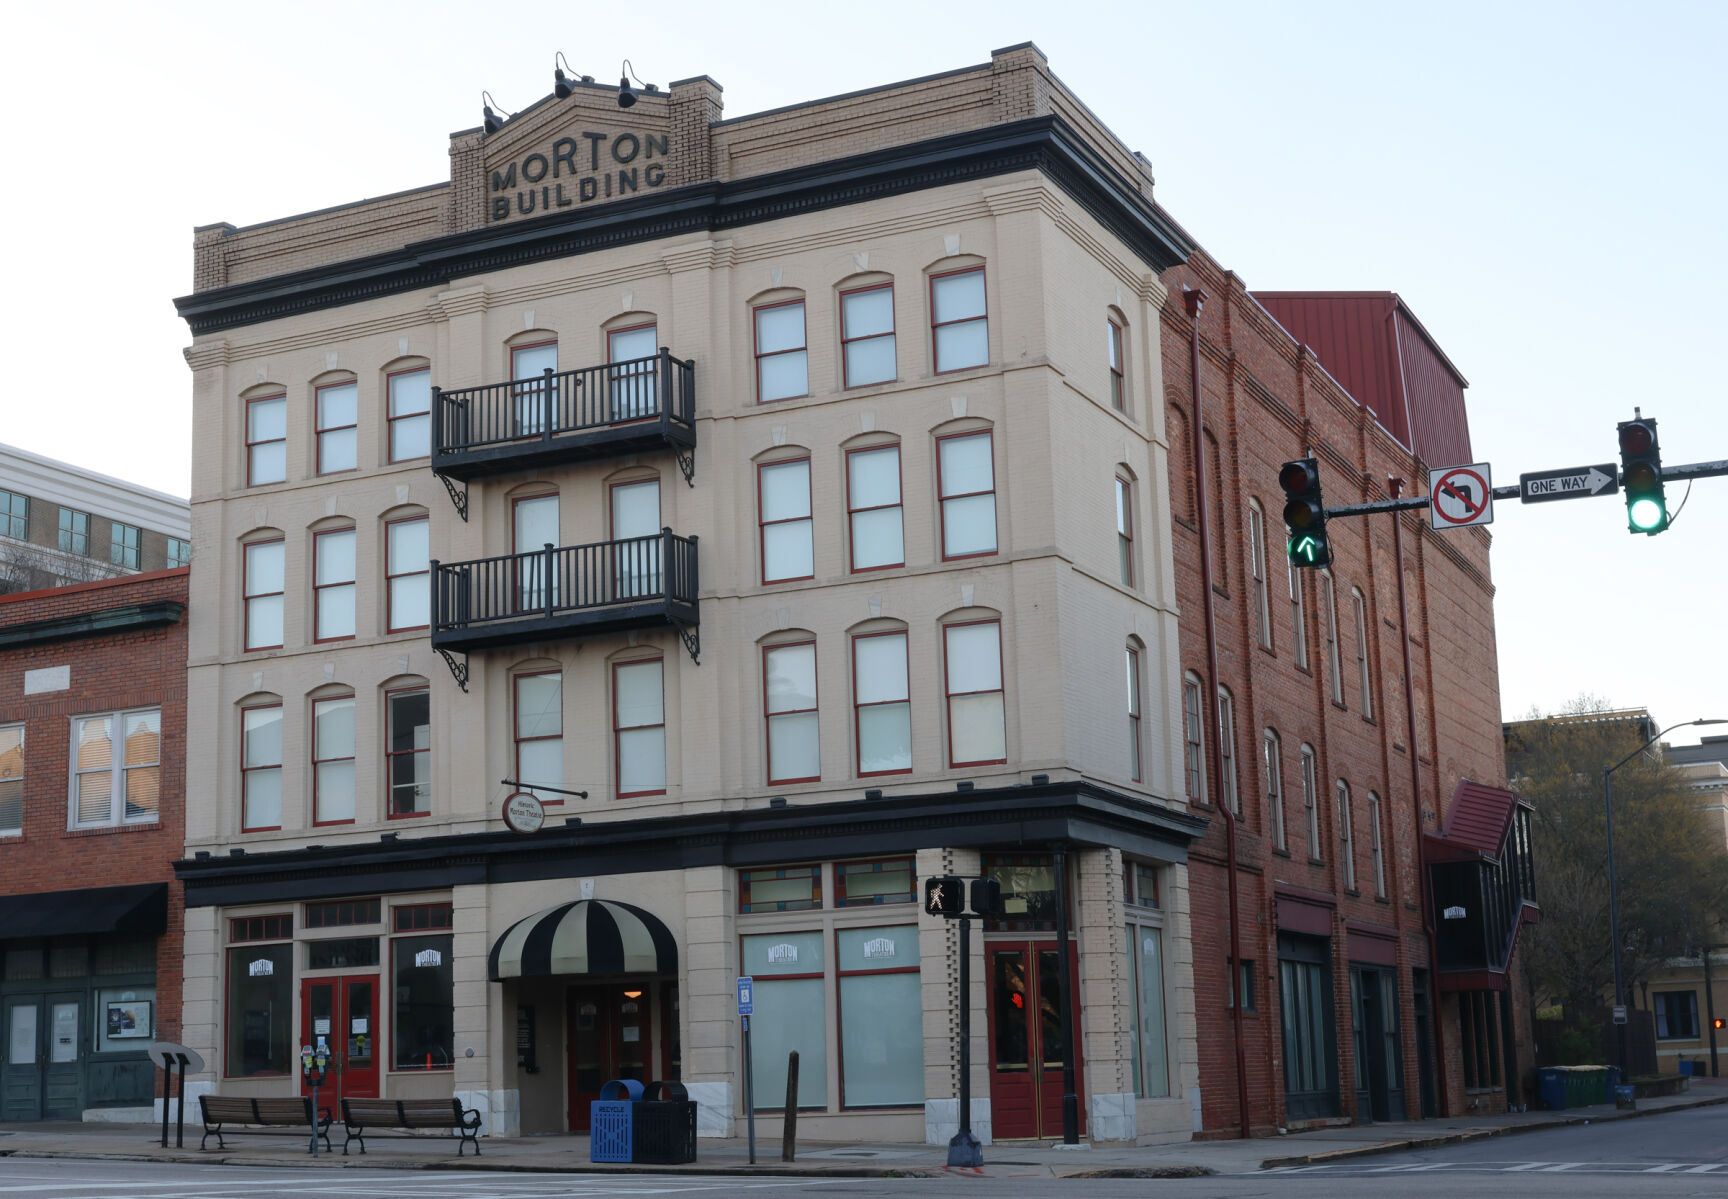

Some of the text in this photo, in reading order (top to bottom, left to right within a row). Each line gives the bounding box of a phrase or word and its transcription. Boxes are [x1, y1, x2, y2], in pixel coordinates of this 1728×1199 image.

[492, 131, 668, 191] MORTON
[492, 162, 665, 220] BUILDING
[1530, 476, 1588, 493] ONE WAY
[768, 944, 798, 962] MORTON
[864, 938, 895, 957] MORTON
[249, 958, 274, 976] MORTON
[416, 949, 441, 967] MORTON
[599, 1105, 625, 1113] RECYCLE
